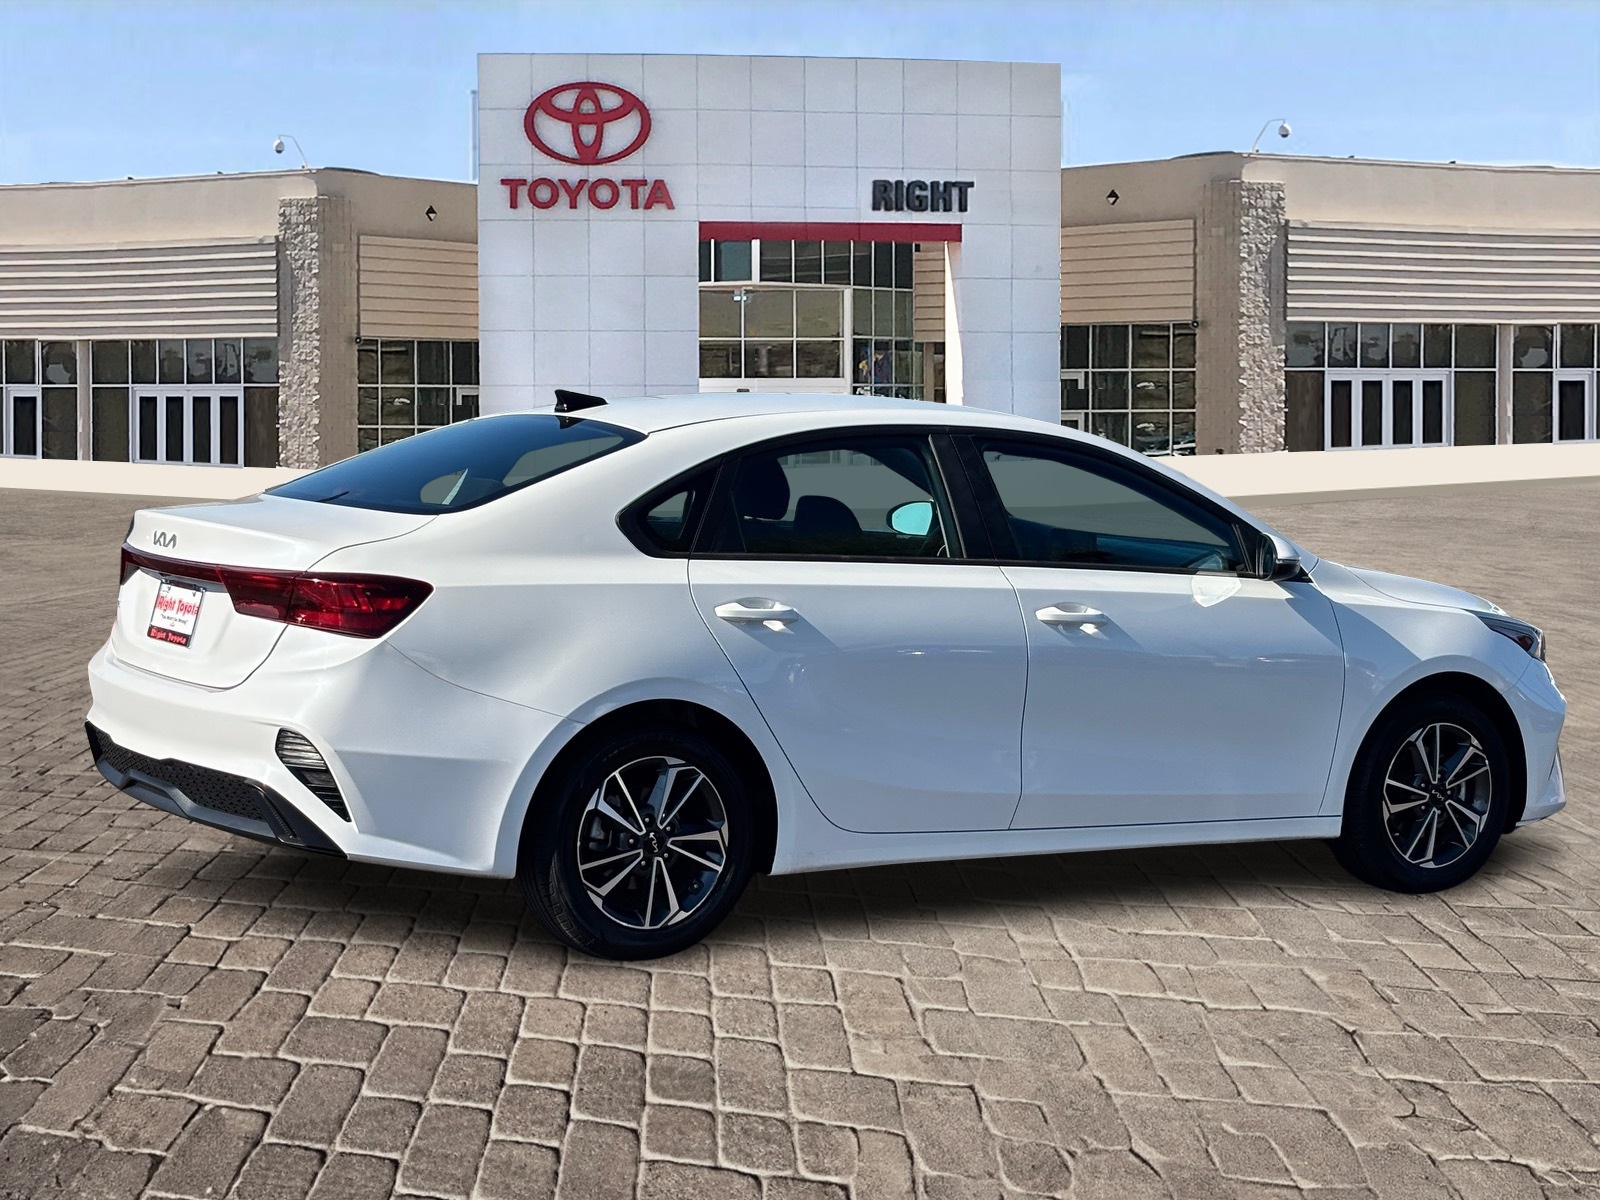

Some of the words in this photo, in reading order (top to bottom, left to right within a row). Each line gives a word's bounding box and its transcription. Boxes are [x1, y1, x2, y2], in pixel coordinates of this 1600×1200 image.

[500, 177, 675, 210] TOYOTA
[872, 180, 974, 212] RIGHT
[153, 530, 177, 549] KIA
[157, 595, 175, 612] Right
[176, 599, 200, 616] Toyota
